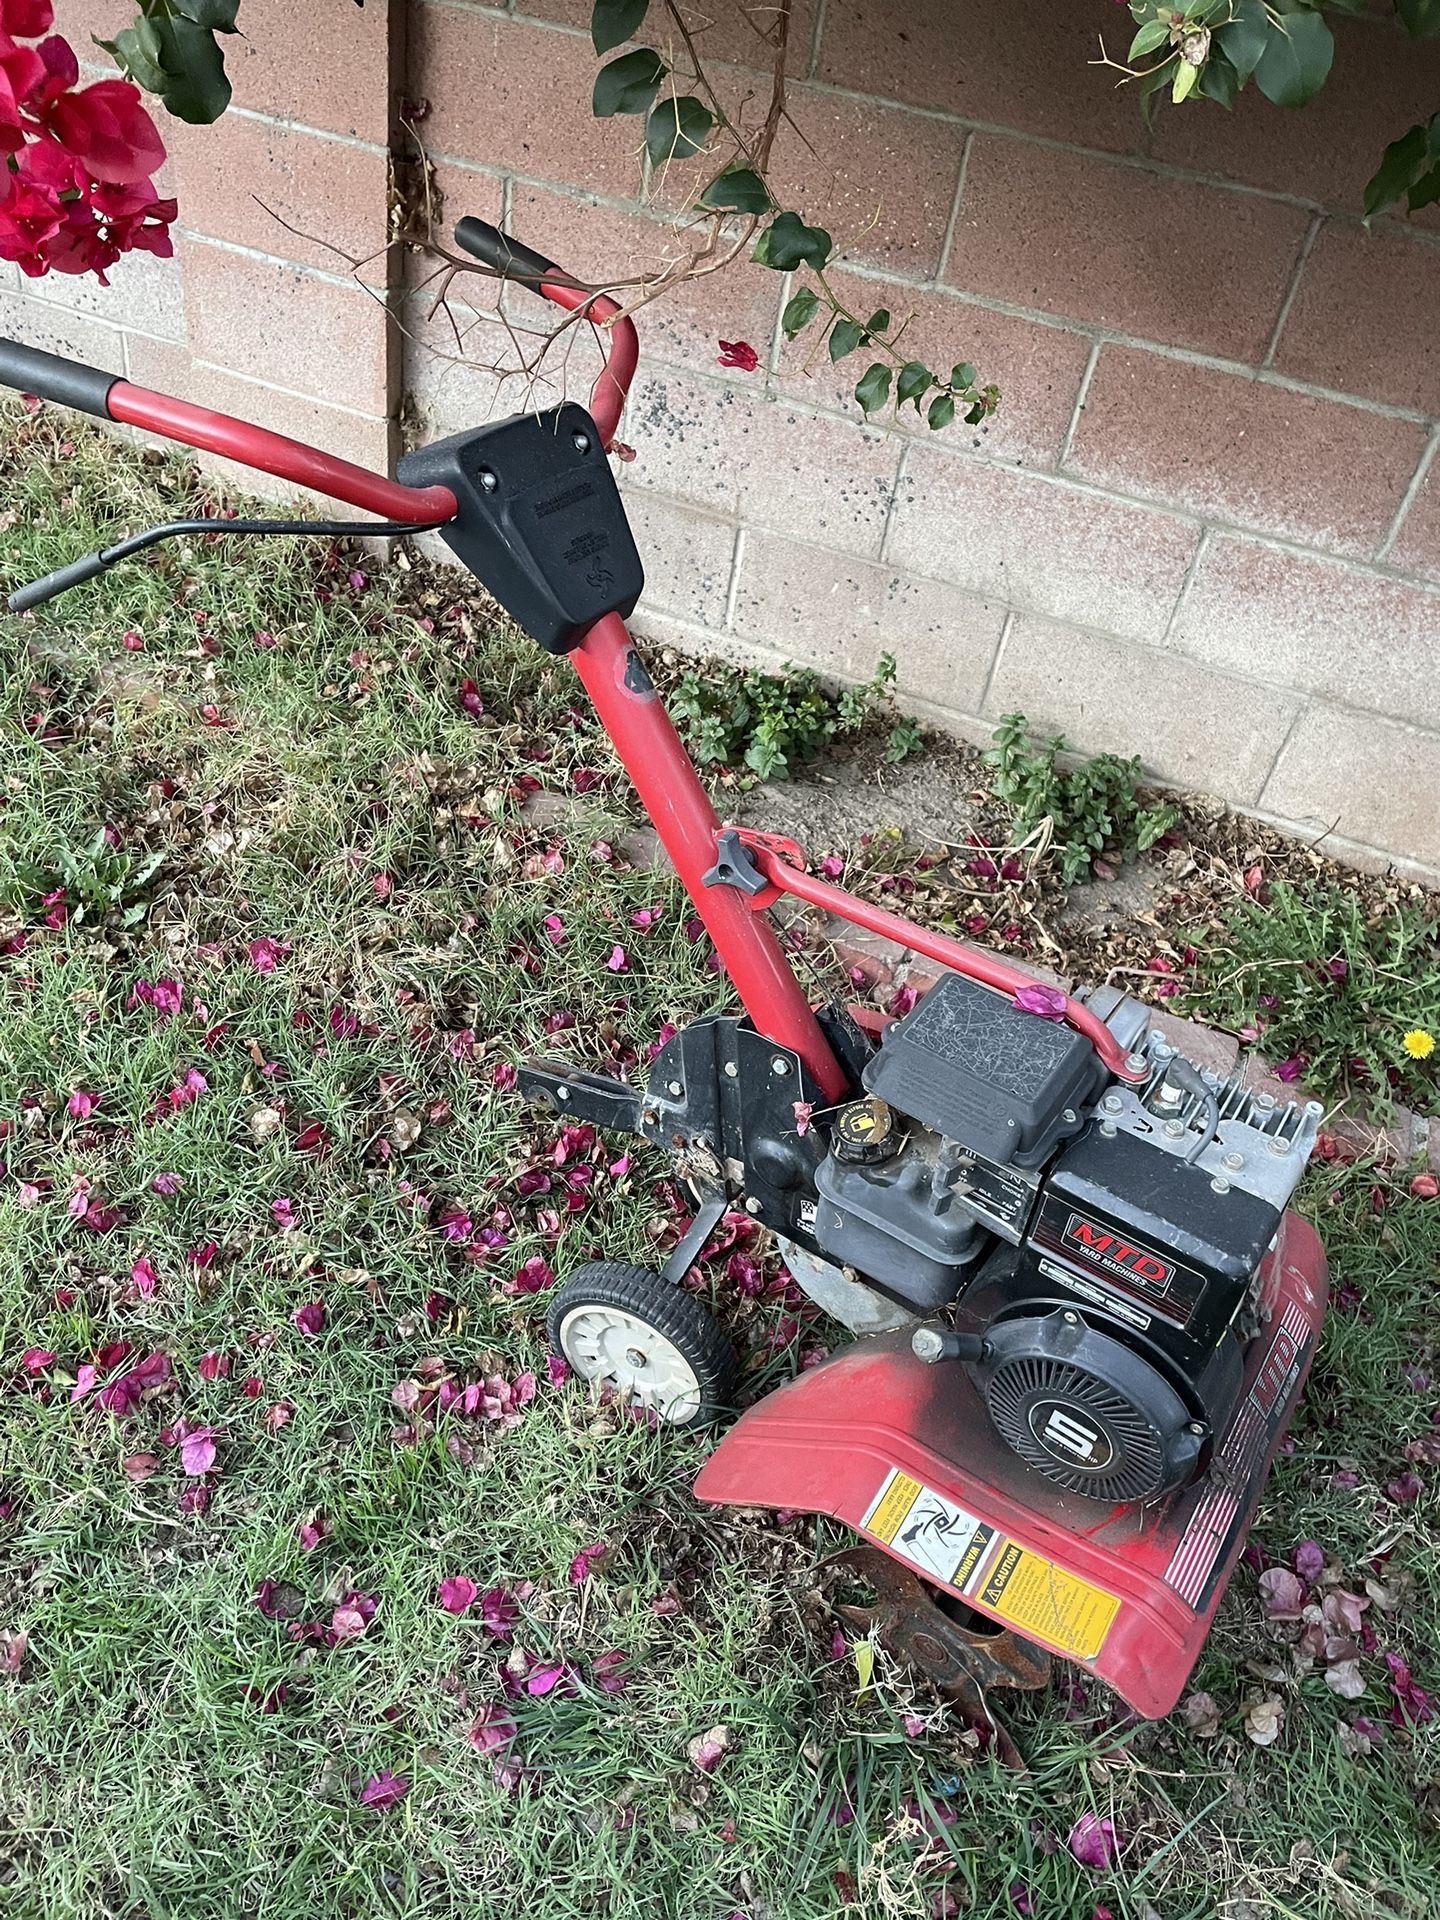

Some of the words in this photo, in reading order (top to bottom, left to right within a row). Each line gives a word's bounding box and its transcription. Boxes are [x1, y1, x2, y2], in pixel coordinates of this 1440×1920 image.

[1072, 1223, 1166, 1281] MTD
[1079, 1245, 1102, 1261] YARD
[1102, 1258, 1148, 1286] MACHINES
[1044, 1410, 1098, 1458] 5
[952, 1546, 981, 1587] WARNING
[994, 1546, 1020, 1587] CAUTION
